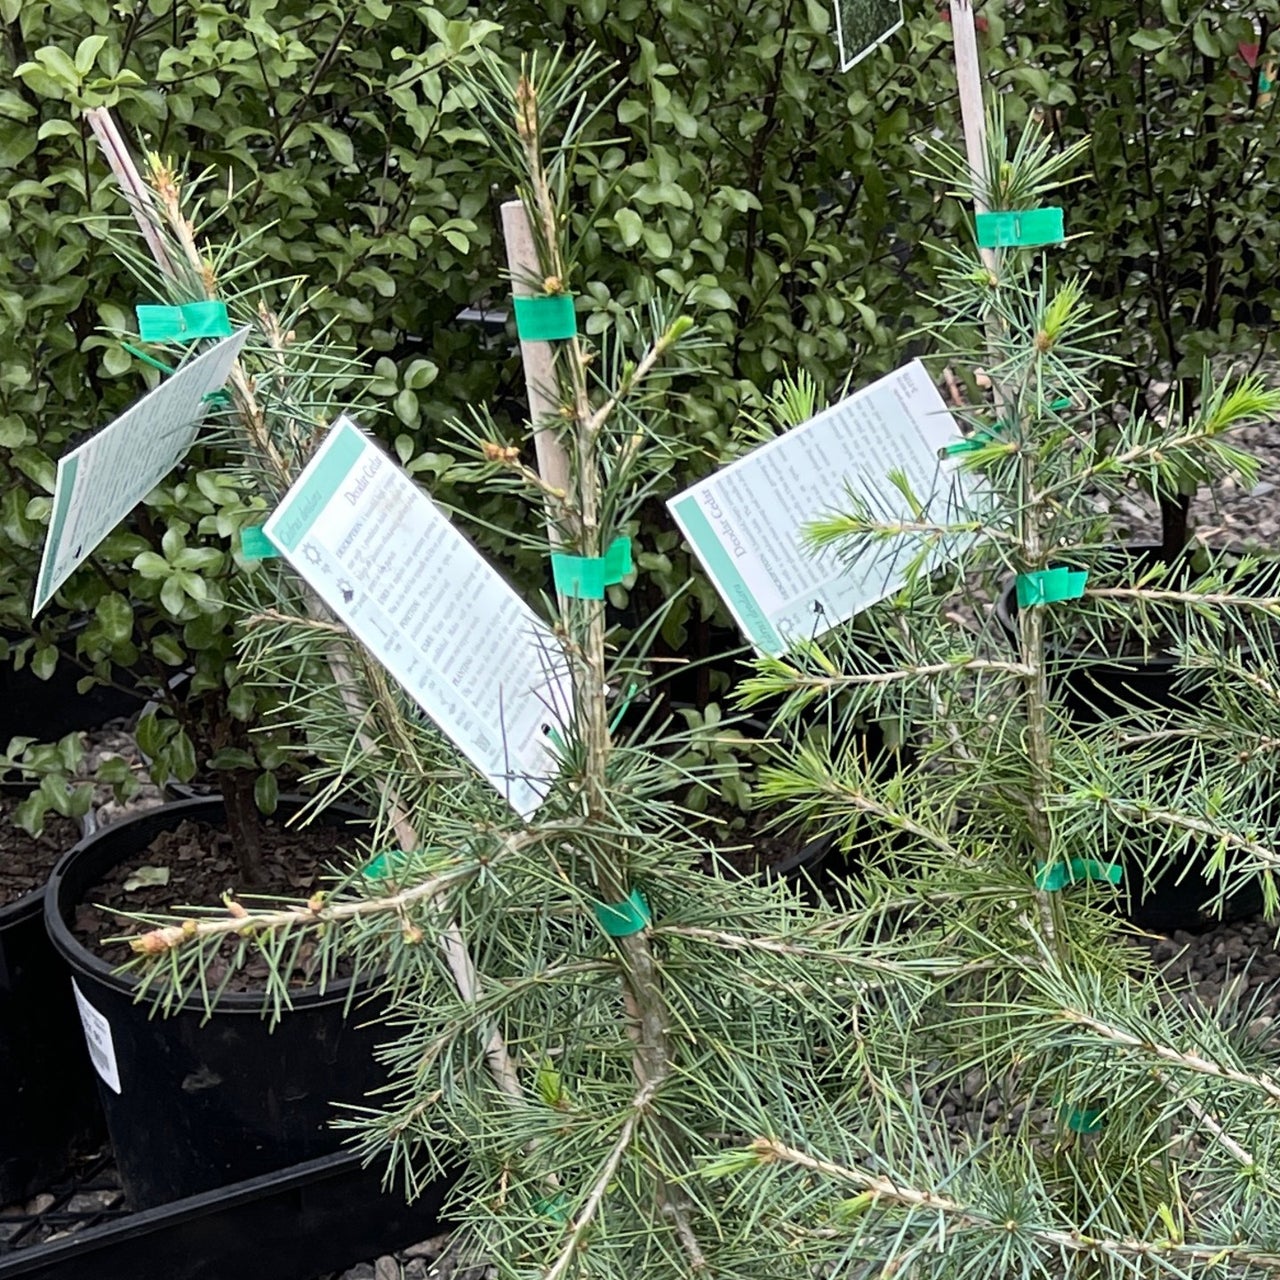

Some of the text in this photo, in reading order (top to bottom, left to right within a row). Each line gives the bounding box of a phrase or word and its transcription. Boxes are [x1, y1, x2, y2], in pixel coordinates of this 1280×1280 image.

[344, 455, 383, 506] Deodar Cedar
[702, 487, 747, 559] Deodar Cedar
